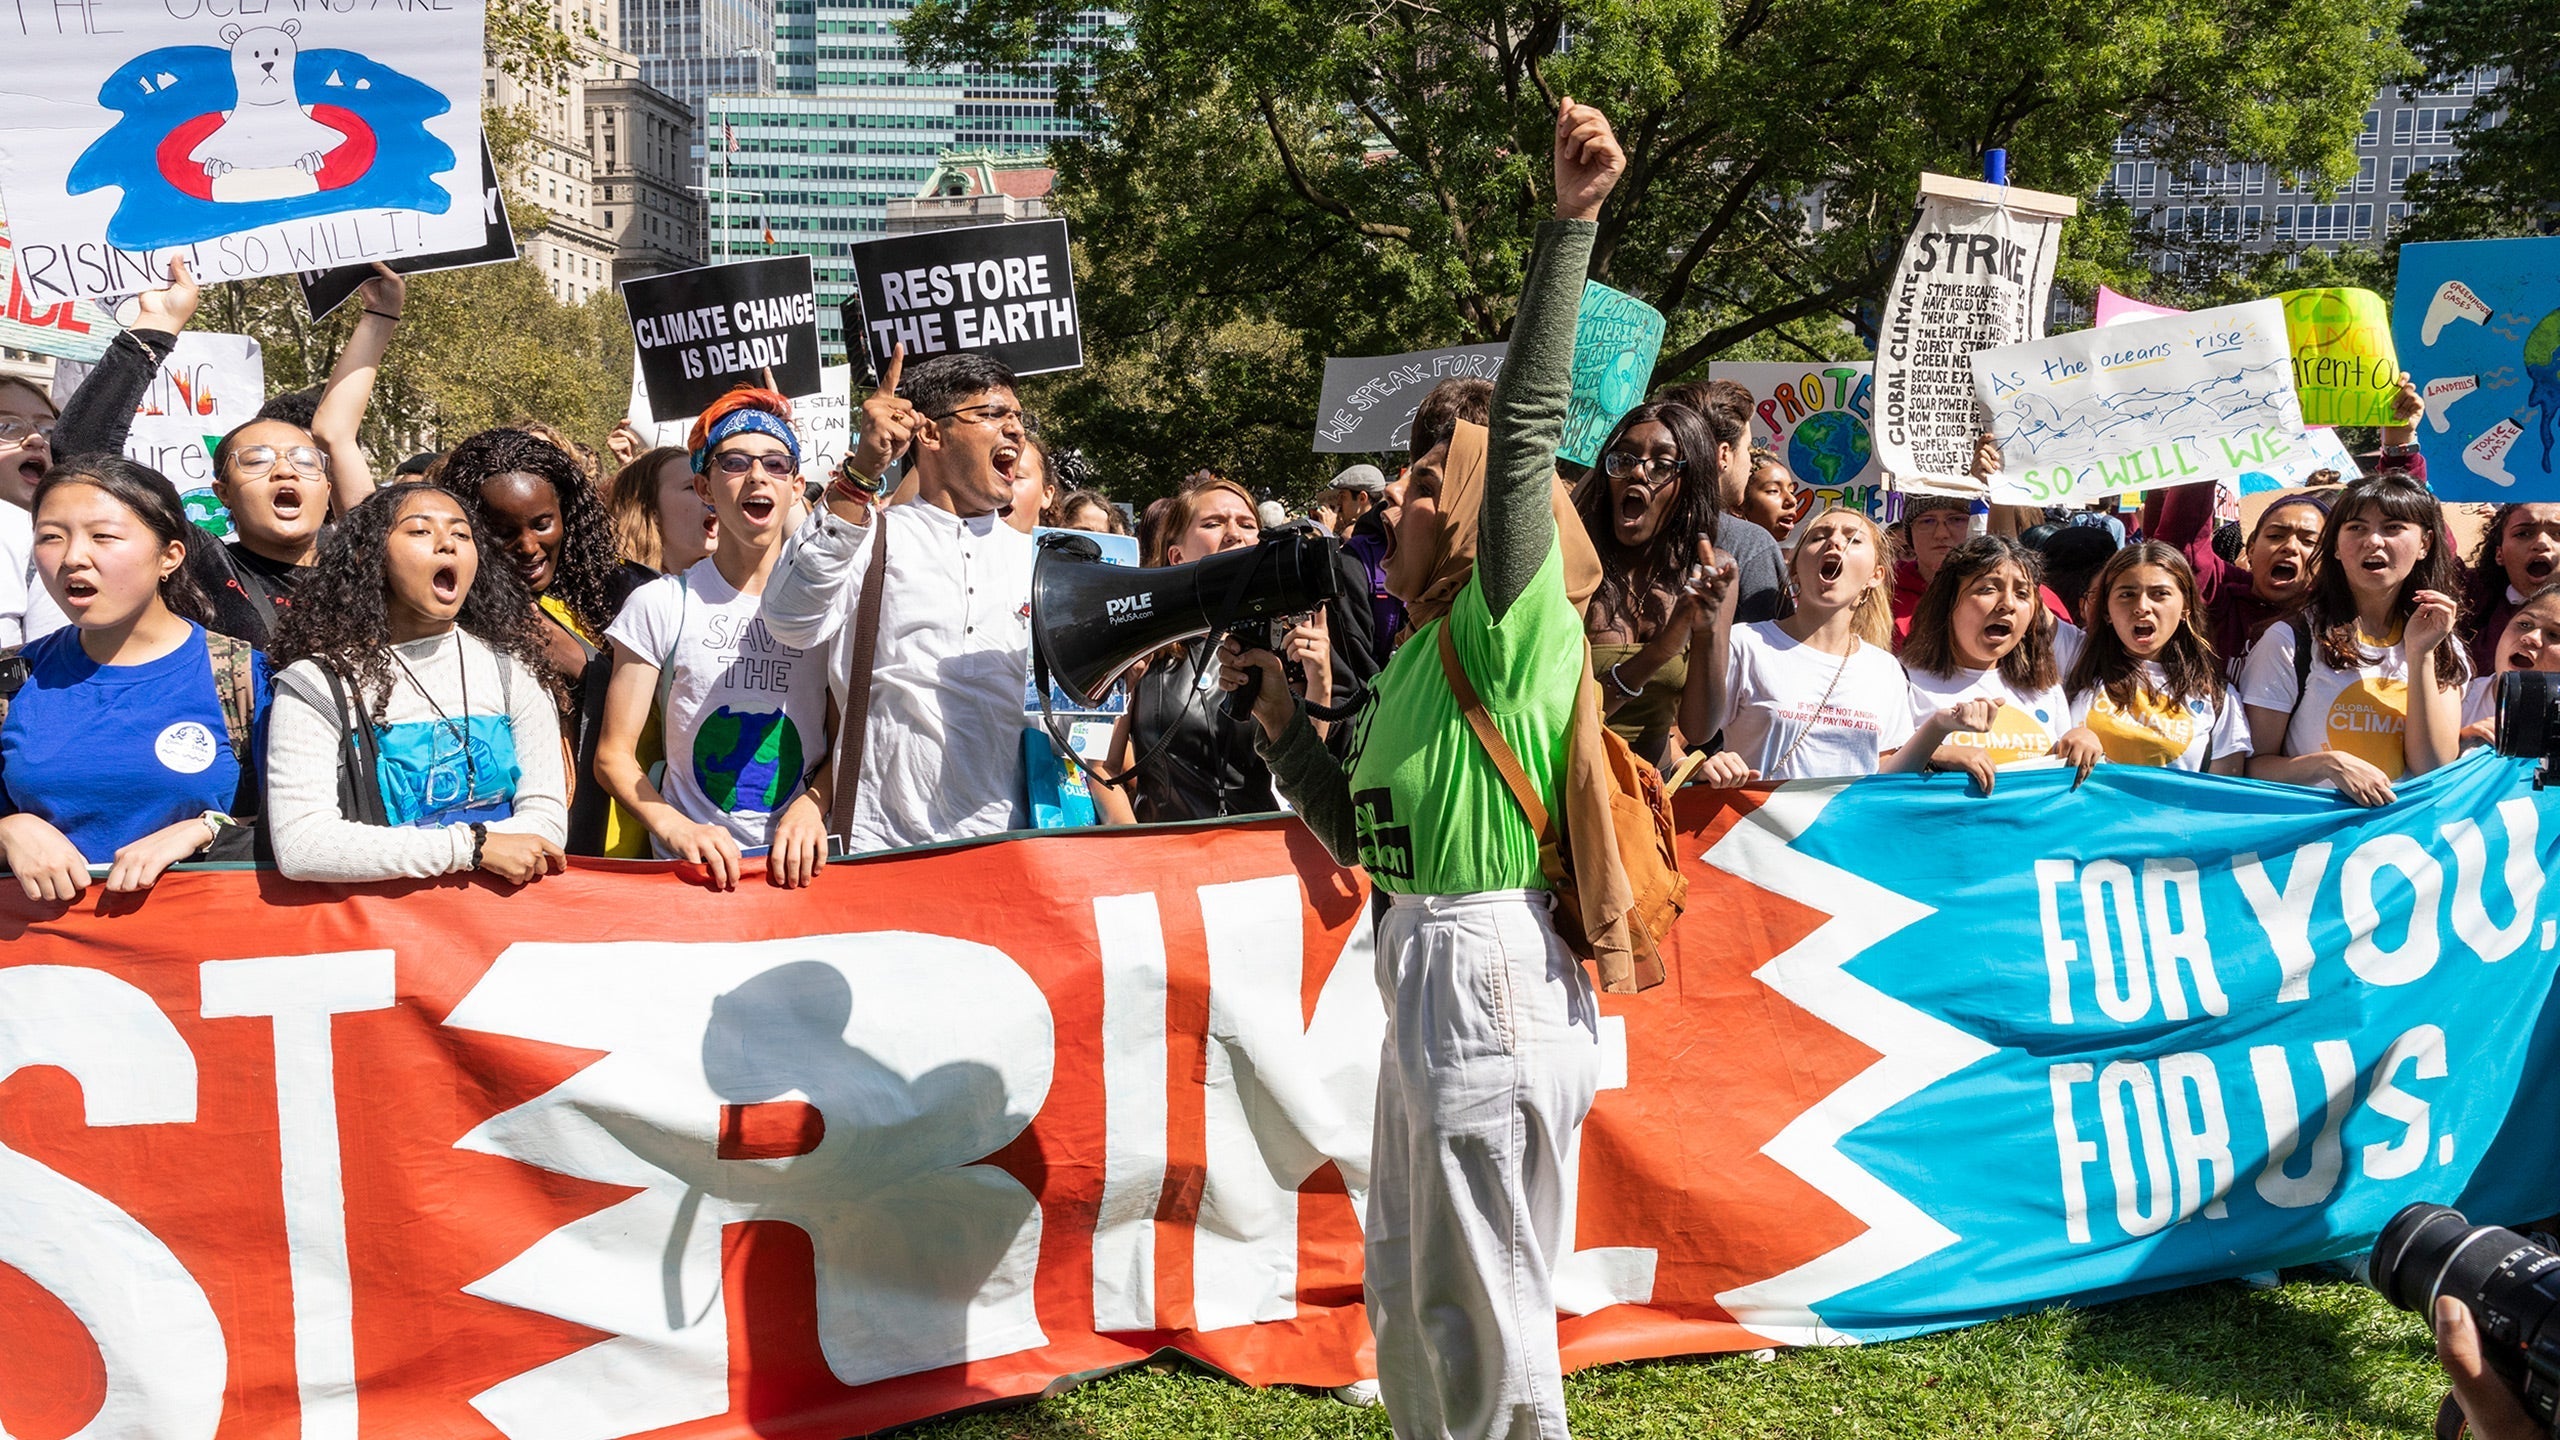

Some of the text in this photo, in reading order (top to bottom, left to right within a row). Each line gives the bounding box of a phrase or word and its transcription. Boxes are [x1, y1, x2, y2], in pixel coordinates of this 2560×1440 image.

[22, 242, 203, 300] RISING!
[219, 236, 269, 276] SO
[281, 217, 378, 269] WILL
[1914, 233, 2027, 286] STRIKE
[880, 254, 1052, 313] RESTORE
[1926, 283, 1963, 297] STRIKE
[1965, 285, 1999, 300] BECAUSE
[1921, 297, 1946, 311] HAVE
[1949, 299, 1974, 312] ASKED
[1976, 299, 1989, 311] US
[2443, 290, 2471, 311] GASES
[636, 292, 815, 350] CLIMATE CHANGE
[872, 297, 1074, 358] THE EARTH
[1920, 312, 1945, 325] THEM
[1946, 313, 1959, 325] UP
[1966, 313, 2002, 326] STRIKE
[1918, 329, 1937, 339] THE
[1939, 326, 1972, 340] EARTH
[1974, 330, 1986, 340] IS
[680, 333, 789, 380] IS DEADLY
[1915, 340, 1928, 353] SO
[1929, 340, 1954, 354] FAST
[1888, 273, 1920, 446] GLOBAL CLIMATE
[1912, 353, 1949, 368] GREEN
[1991, 370, 2026, 397] As
[2041, 359, 2088, 382] the
[2101, 341, 2172, 369] oceans
[1911, 369, 1948, 384] BECAUSE
[1910, 384, 1932, 396] BACK
[1935, 385, 1962, 396] WHEN
[2427, 378, 2475, 398] LANDFILLS
[810, 394, 849, 409] STEAL
[1319, 408, 1363, 444] WE
[1346, 363, 1431, 412] SPEAK
[1433, 354, 1487, 378] FOR
[1908, 398, 1937, 411] SOLAR
[1939, 399, 1969, 411] POWER
[811, 416, 845, 432] CAN
[1908, 411, 1931, 423] NOW
[1935, 412, 1966, 423] STRIKE
[1908, 424, 1932, 437] WHO
[1935, 424, 1966, 438] CAUSED
[2472, 424, 2507, 454] TOXIC
[1911, 440, 1950, 452] SUFFER
[2482, 427, 2519, 462] WASTE
[1913, 451, 1959, 465] BECAUSE
[2024, 425, 2291, 501] SO WILL WE
[1915, 464, 1954, 476] PLANET
[1105, 592, 1153, 617] PYLE
[1108, 610, 1154, 627] PyleUSA.com
[717, 655, 792, 693] THE
[1835, 707, 1852, 717] NOT
[2333, 703, 2377, 713] GLOBAL
[1777, 709, 1794, 720] YOU
[1822, 716, 1853, 728] PAYING
[1953, 731, 2050, 751] CLIMATE
[2034, 796, 2557, 1025] FOR YOU,
[2049, 1023, 2454, 1244] FOR US.
